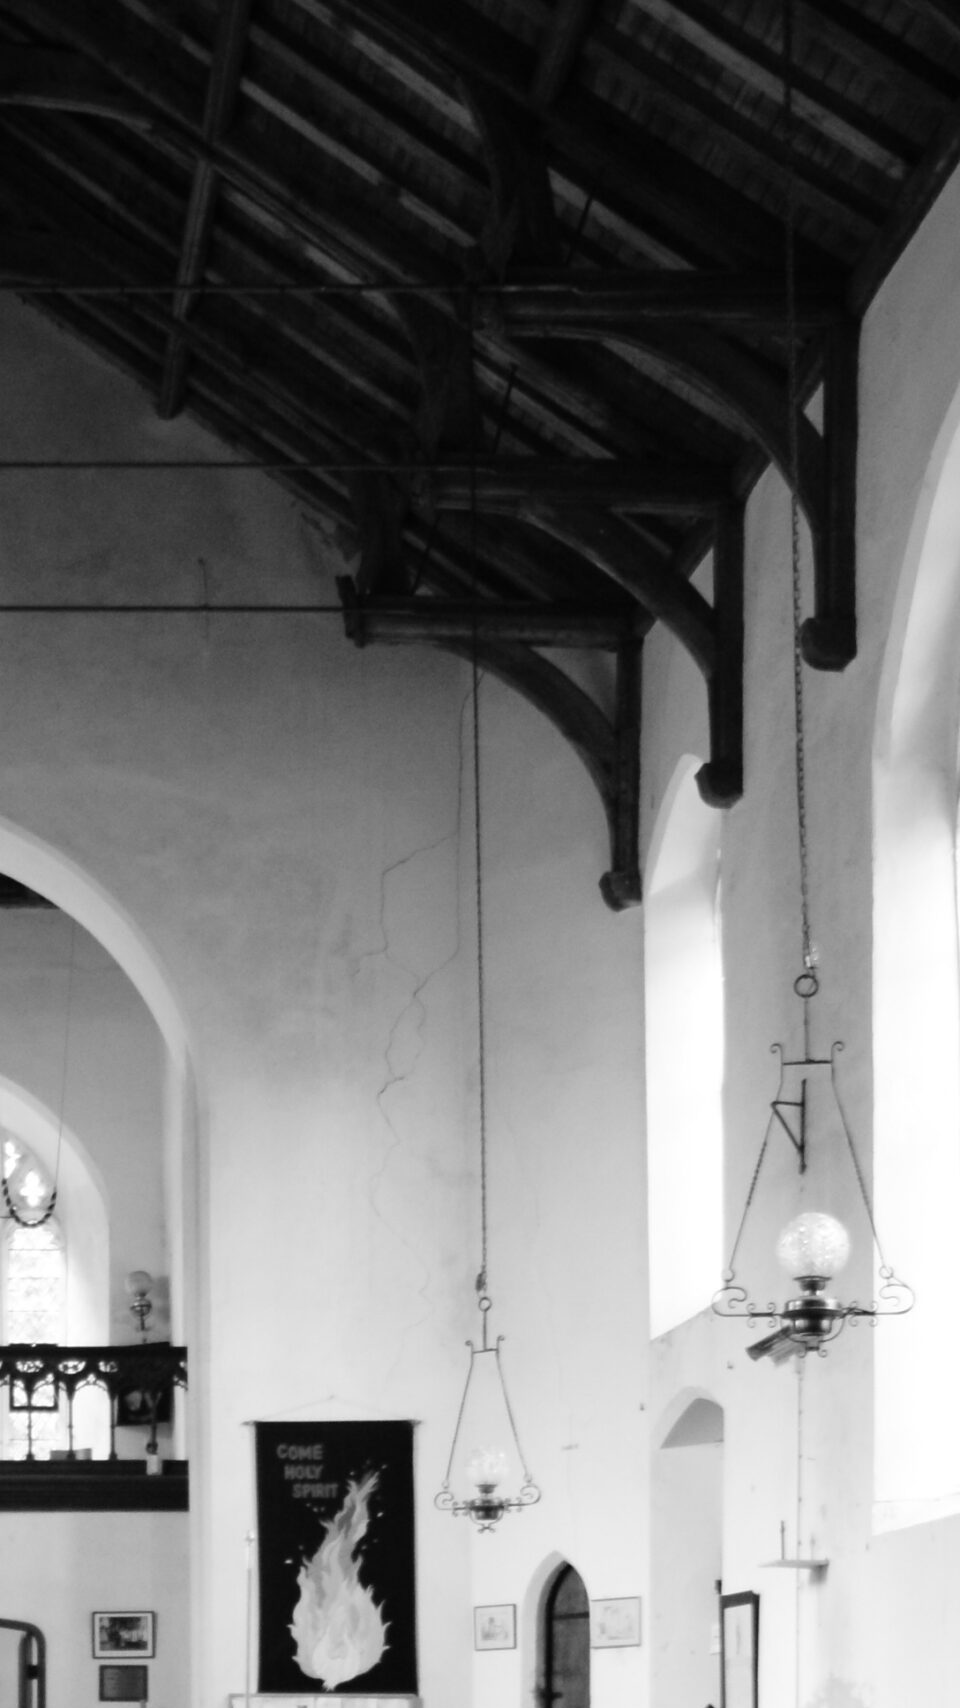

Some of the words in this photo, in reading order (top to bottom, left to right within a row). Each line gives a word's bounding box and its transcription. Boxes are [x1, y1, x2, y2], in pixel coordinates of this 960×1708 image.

[276, 1443, 324, 1461] COME
[284, 1464, 324, 1480] HOLY
[292, 1483, 339, 1498] SPIRIT
